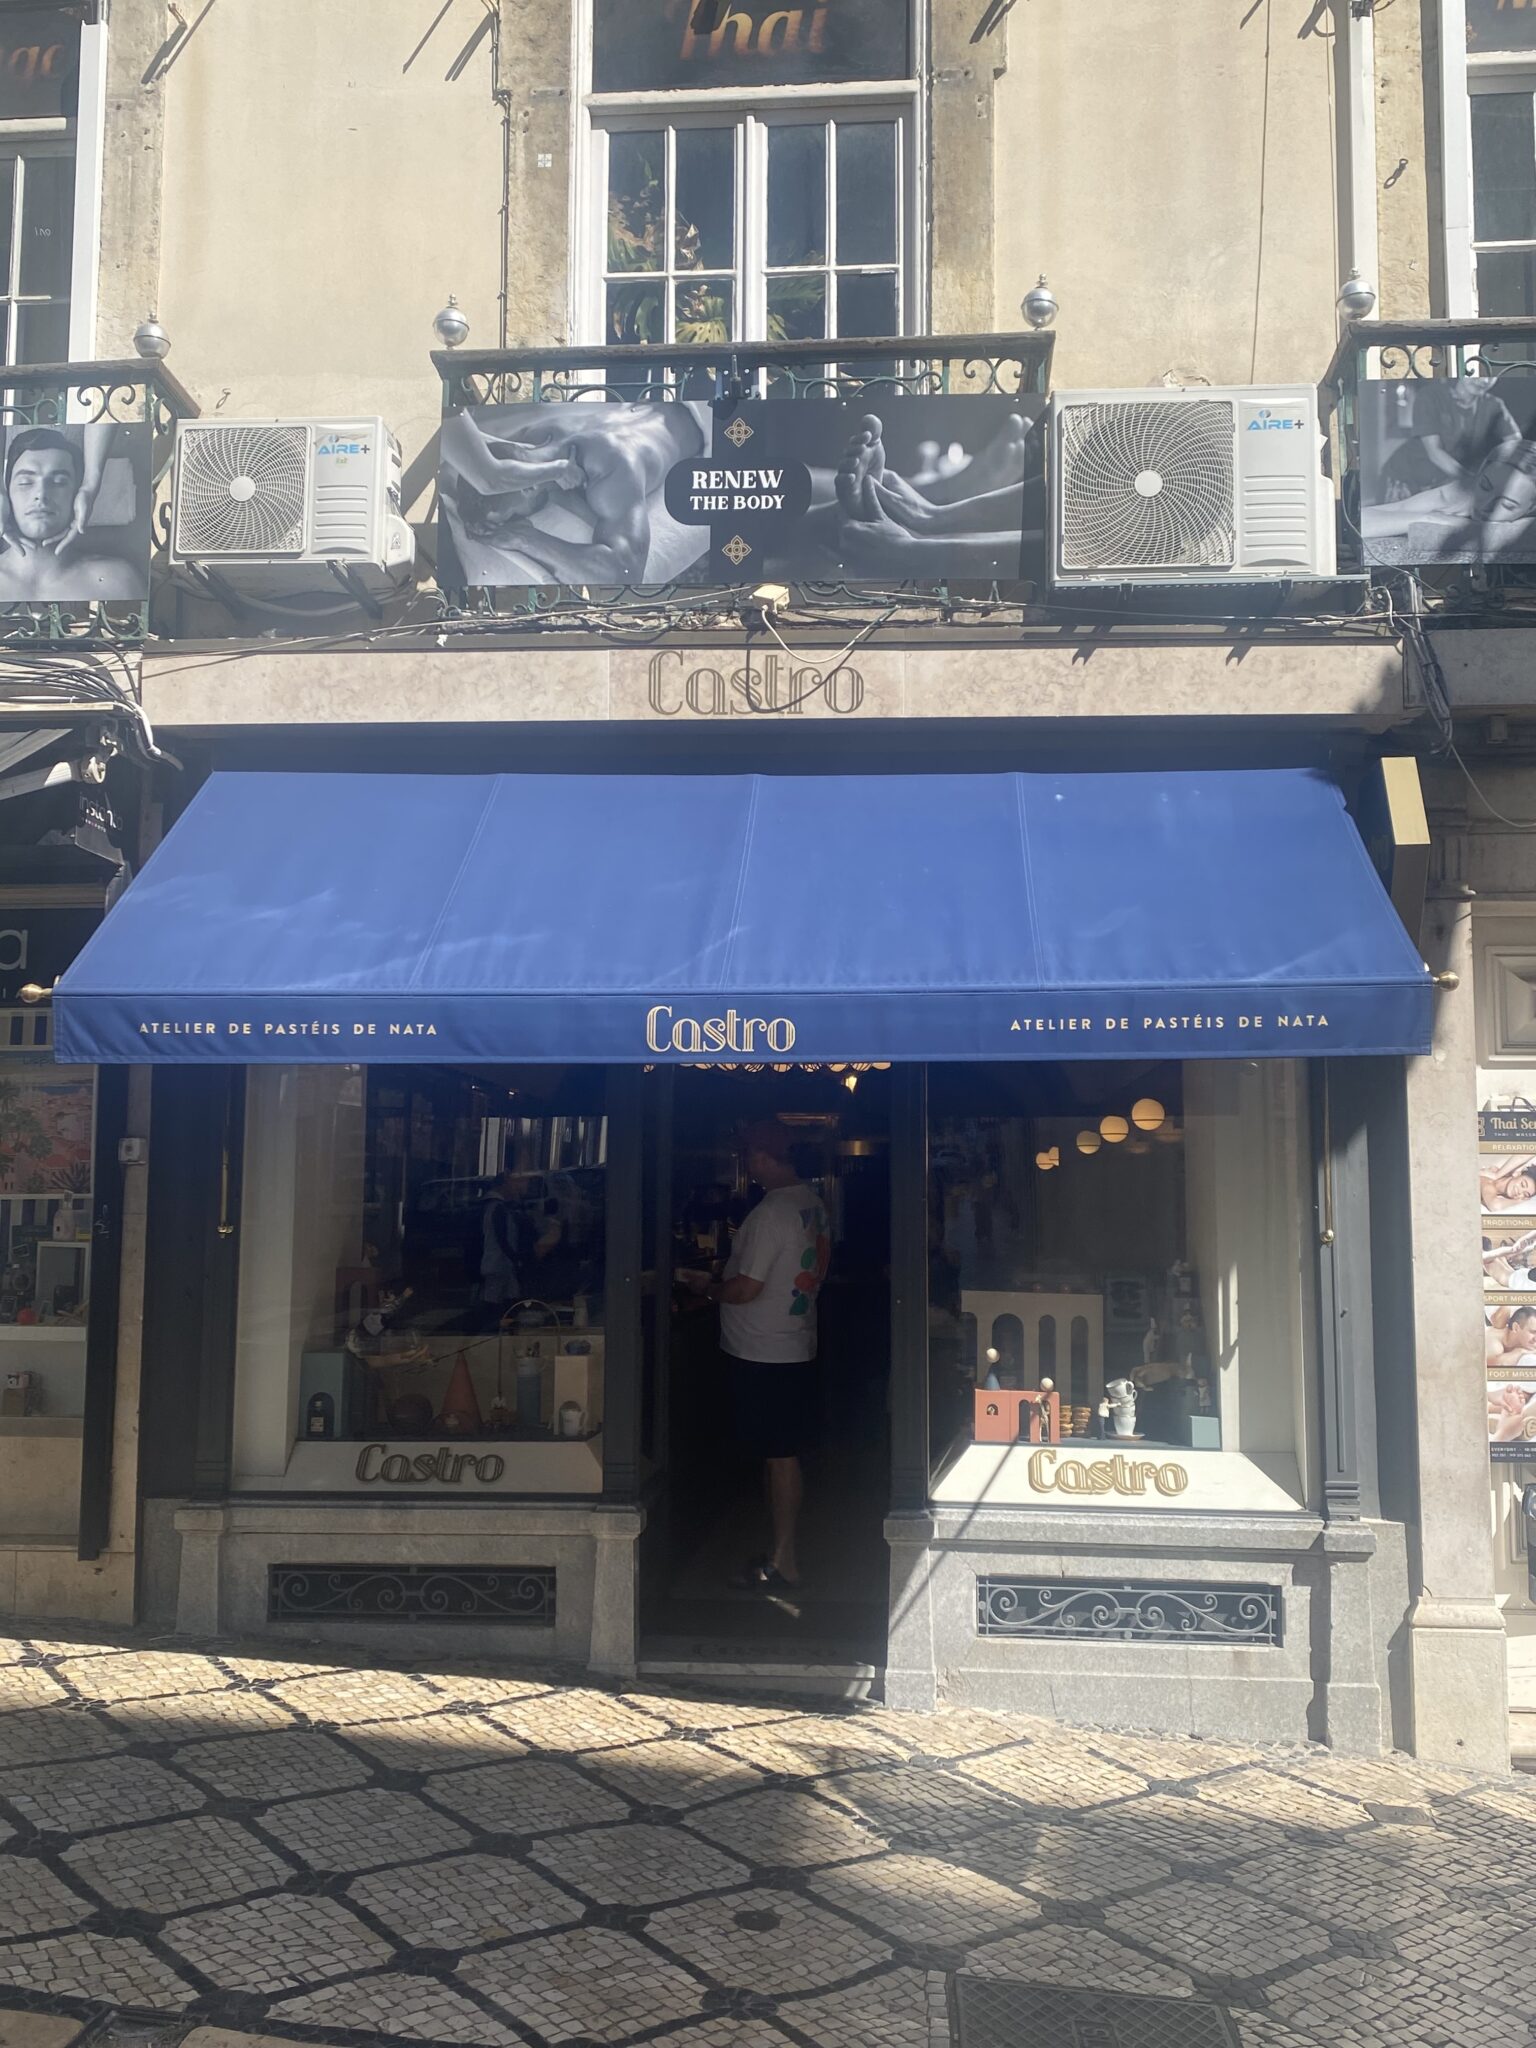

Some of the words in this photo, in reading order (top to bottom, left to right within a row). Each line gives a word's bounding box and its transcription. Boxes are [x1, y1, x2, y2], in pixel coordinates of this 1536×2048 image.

[1247, 419, 1304, 430] AIRE+
[692, 469, 784, 489] RENEW
[689, 495, 729, 510] THE
[733, 494, 785, 510] BODY
[648, 650, 864, 716] Castro
[139, 1022, 216, 1034] ATELIER
[228, 1023, 252, 1035] DE
[264, 1021, 340, 1035] PASTÉIS
[353, 1023, 377, 1035] DE
[389, 1024, 437, 1036] NATA
[646, 1005, 796, 1053] Castro
[1010, 1018, 1092, 1031] ATELIER
[1105, 1017, 1129, 1030] DE
[1143, 1014, 1225, 1029] PASTÉIS
[1239, 1016, 1263, 1028] DE
[1277, 1015, 1329, 1027] NATA
[1490, 1117, 1518, 1130] Thai
[1483, 1219, 1534, 1227] TRADITIONAL
[355, 1443, 505, 1483] Castro
[1028, 1449, 1188, 1497] Castro
